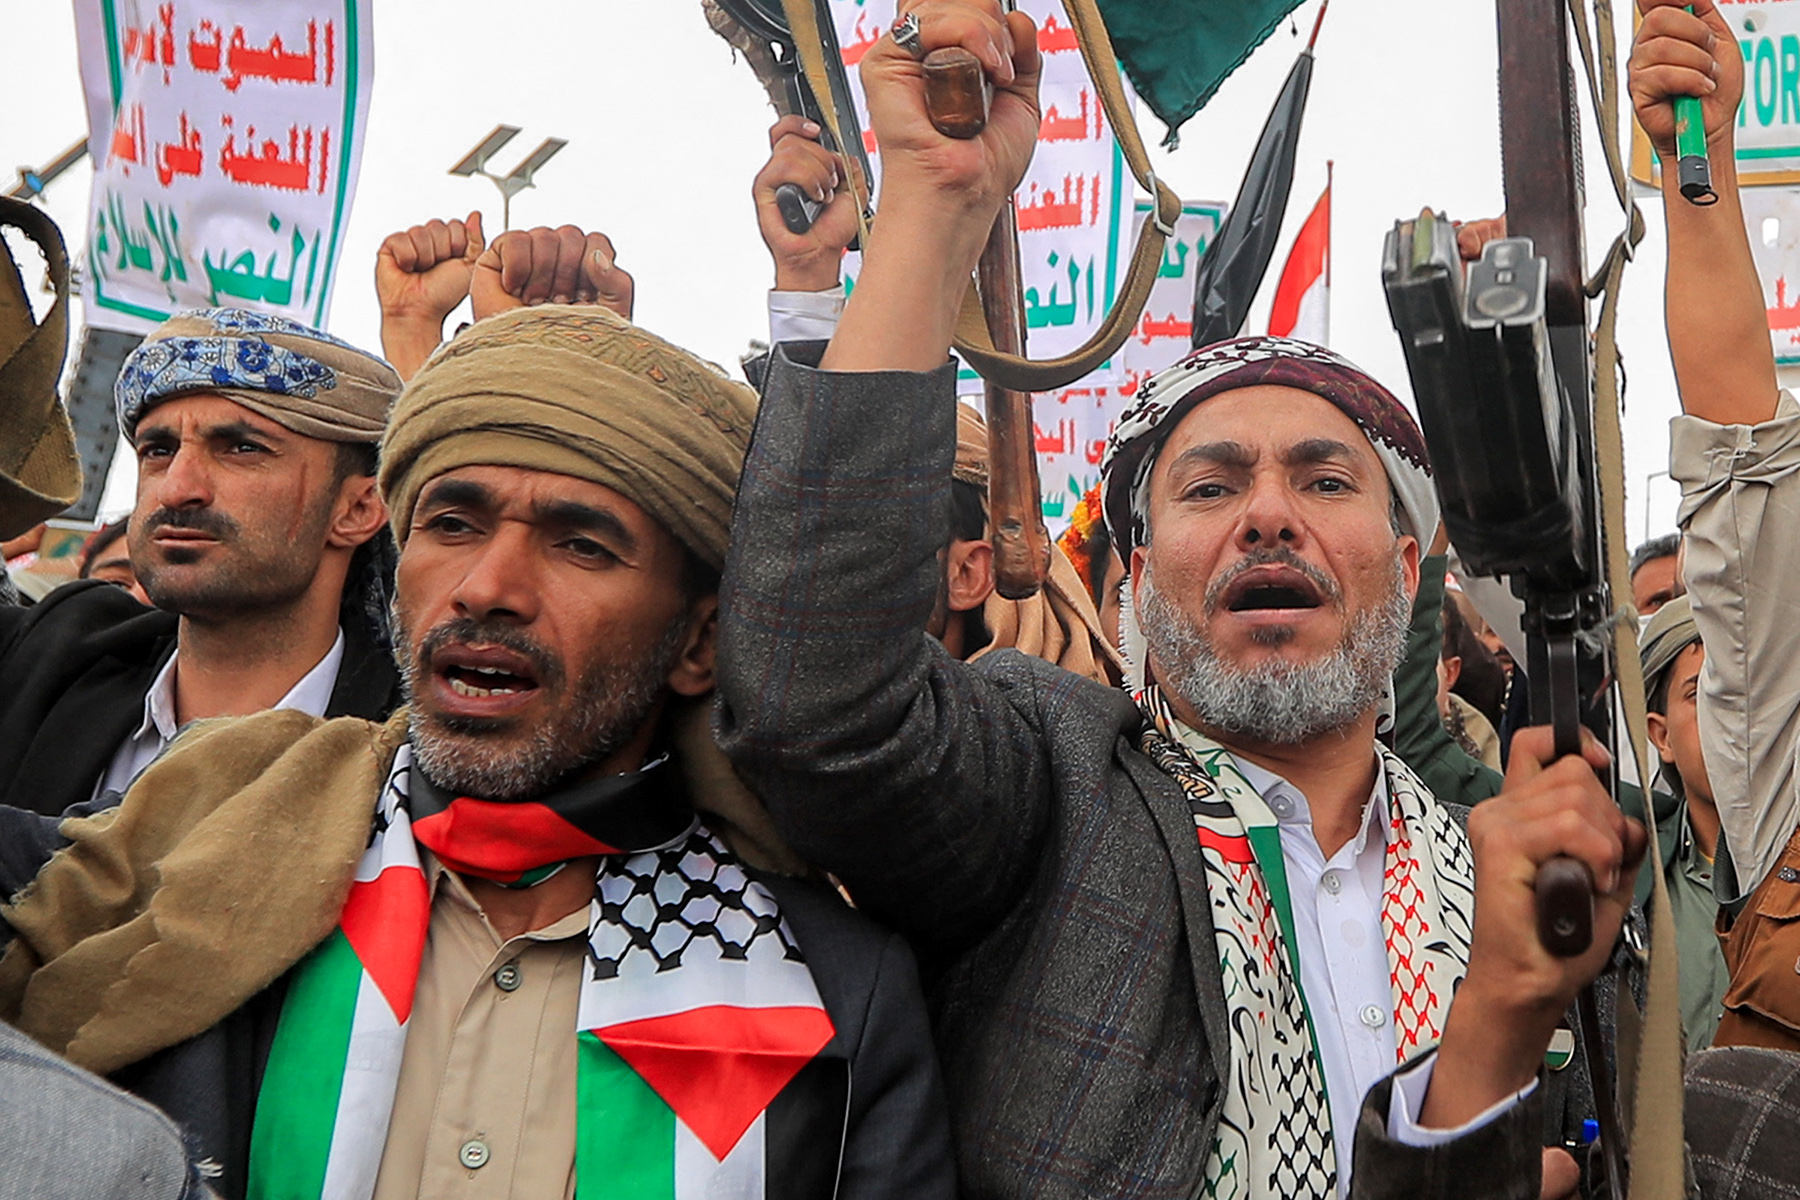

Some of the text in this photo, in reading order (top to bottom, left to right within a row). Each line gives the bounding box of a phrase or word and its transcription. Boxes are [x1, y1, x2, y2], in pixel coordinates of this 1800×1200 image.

[187, 16, 333, 92] الموت
[155, 108, 203, 188] على
[220, 112, 330, 195] اللعنة
[203, 211, 321, 307] النصر
